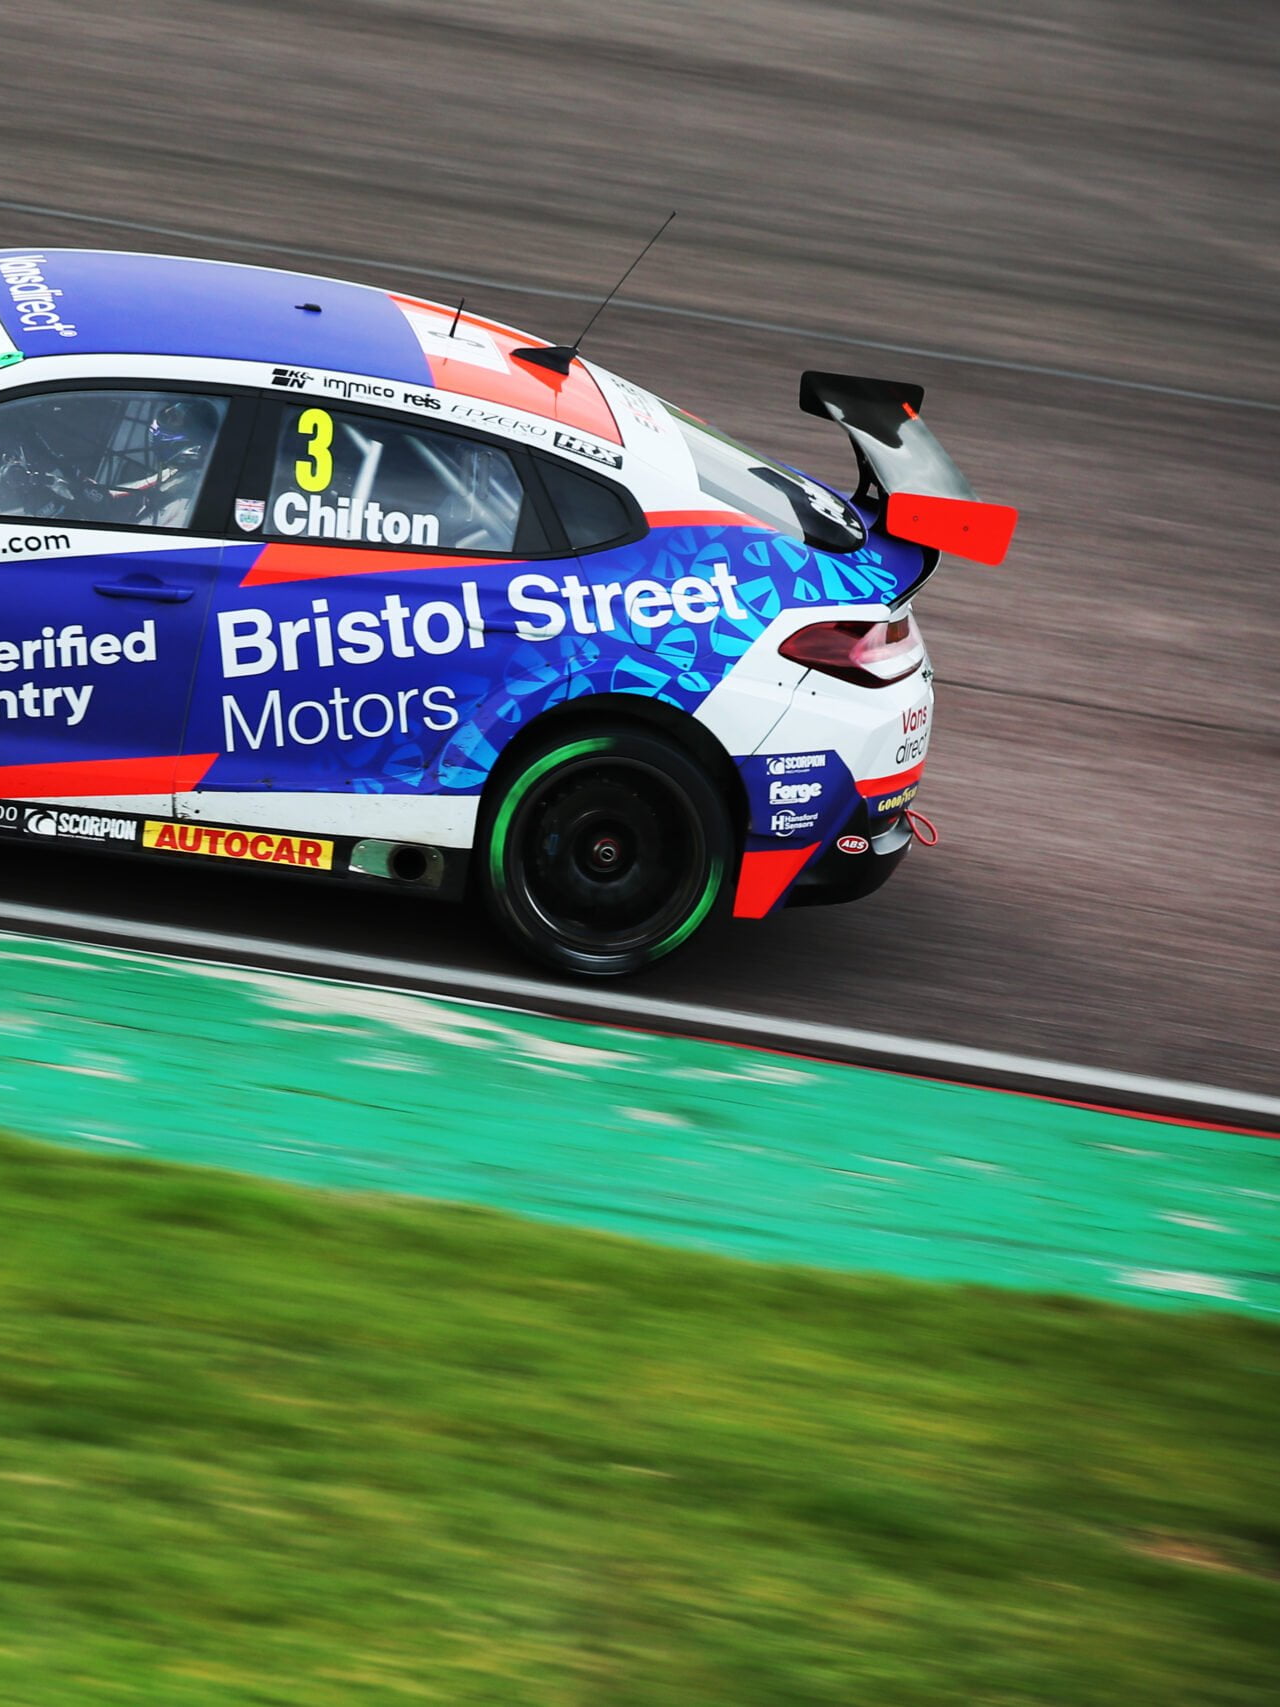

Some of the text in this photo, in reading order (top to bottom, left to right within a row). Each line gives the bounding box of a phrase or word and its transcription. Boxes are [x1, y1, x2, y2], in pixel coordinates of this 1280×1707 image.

[294, 407, 334, 493] 3
[323, 375, 395, 399] immico
[403, 393, 442, 411] reis
[556, 434, 620, 468] HRX
[272, 490, 440, 547] Chilton
[217, 563, 747, 680] Bristol Street
[221, 685, 461, 754] Motors
[902, 705, 928, 735] Vans
[57, 813, 137, 841] SCORPION
[154, 823, 322, 868] AUTOCAR
[841, 840, 865, 849] ABS
